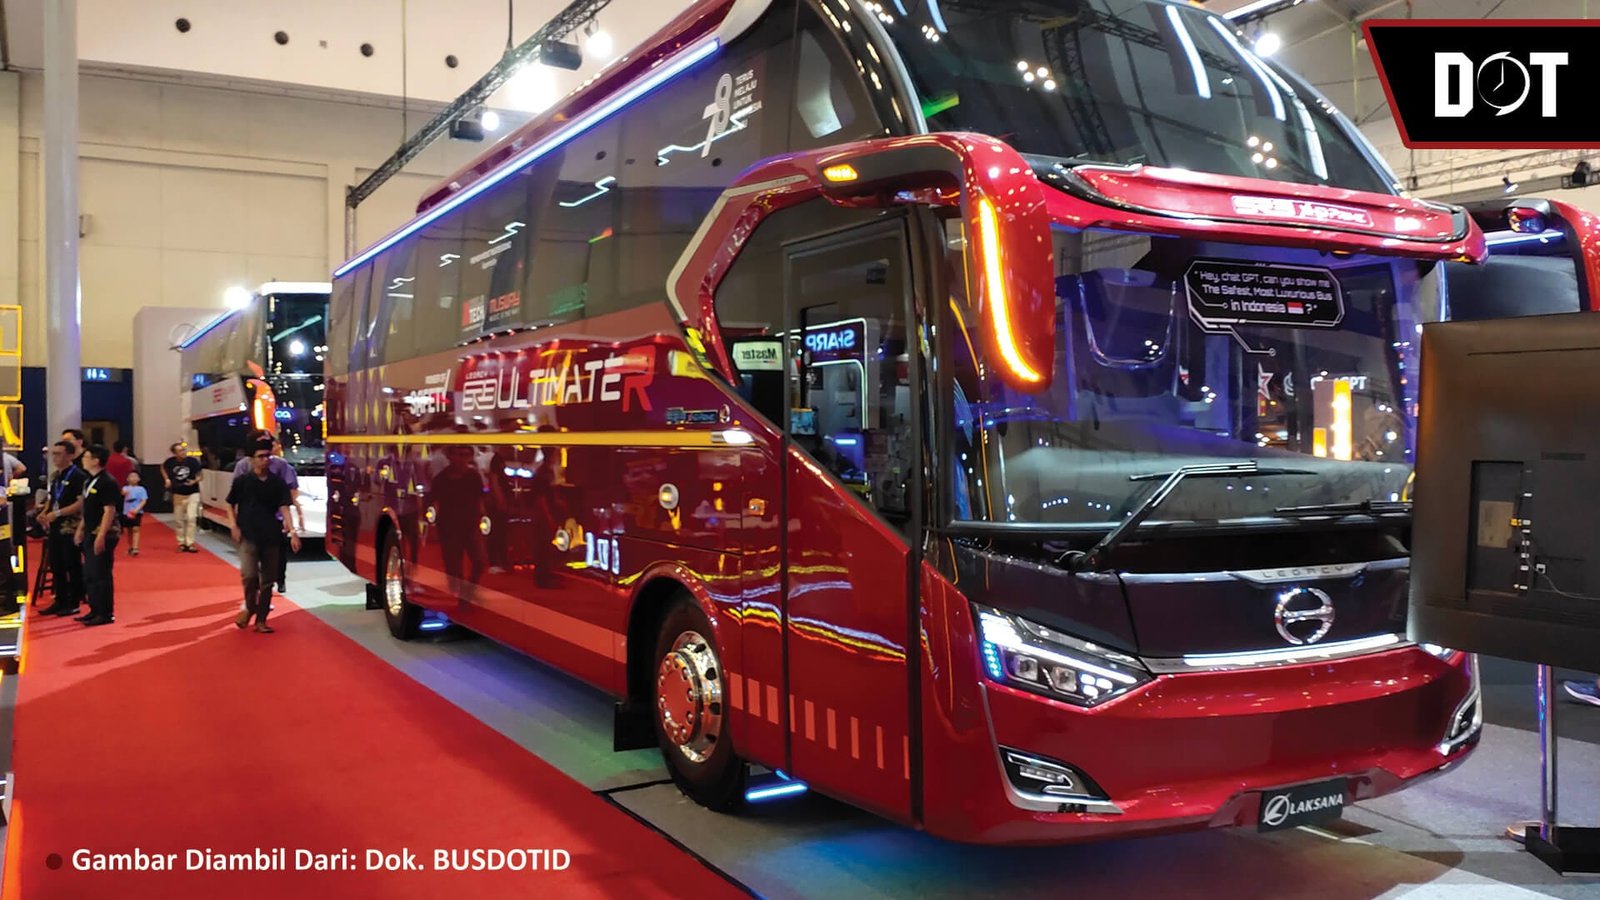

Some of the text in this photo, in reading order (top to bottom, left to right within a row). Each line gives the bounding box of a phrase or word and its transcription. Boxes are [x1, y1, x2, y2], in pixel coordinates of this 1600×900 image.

[734, 79, 757, 98] MELAJU
[1263, 276, 1279, 284] can
[1280, 277, 1295, 287] you
[1296, 278, 1317, 287] show
[1318, 280, 1331, 288] me
[1202, 284, 1220, 294] The
[1253, 286, 1274, 297] Most
[1275, 288, 1316, 300] Luxurious
[1316, 291, 1333, 301] Bus
[1230, 299, 1241, 311] in
[1241, 300, 1286, 314] Indonesia
[1262, 565, 1344, 578] LEGACY
[1289, 793, 1344, 815] LAKSANA
